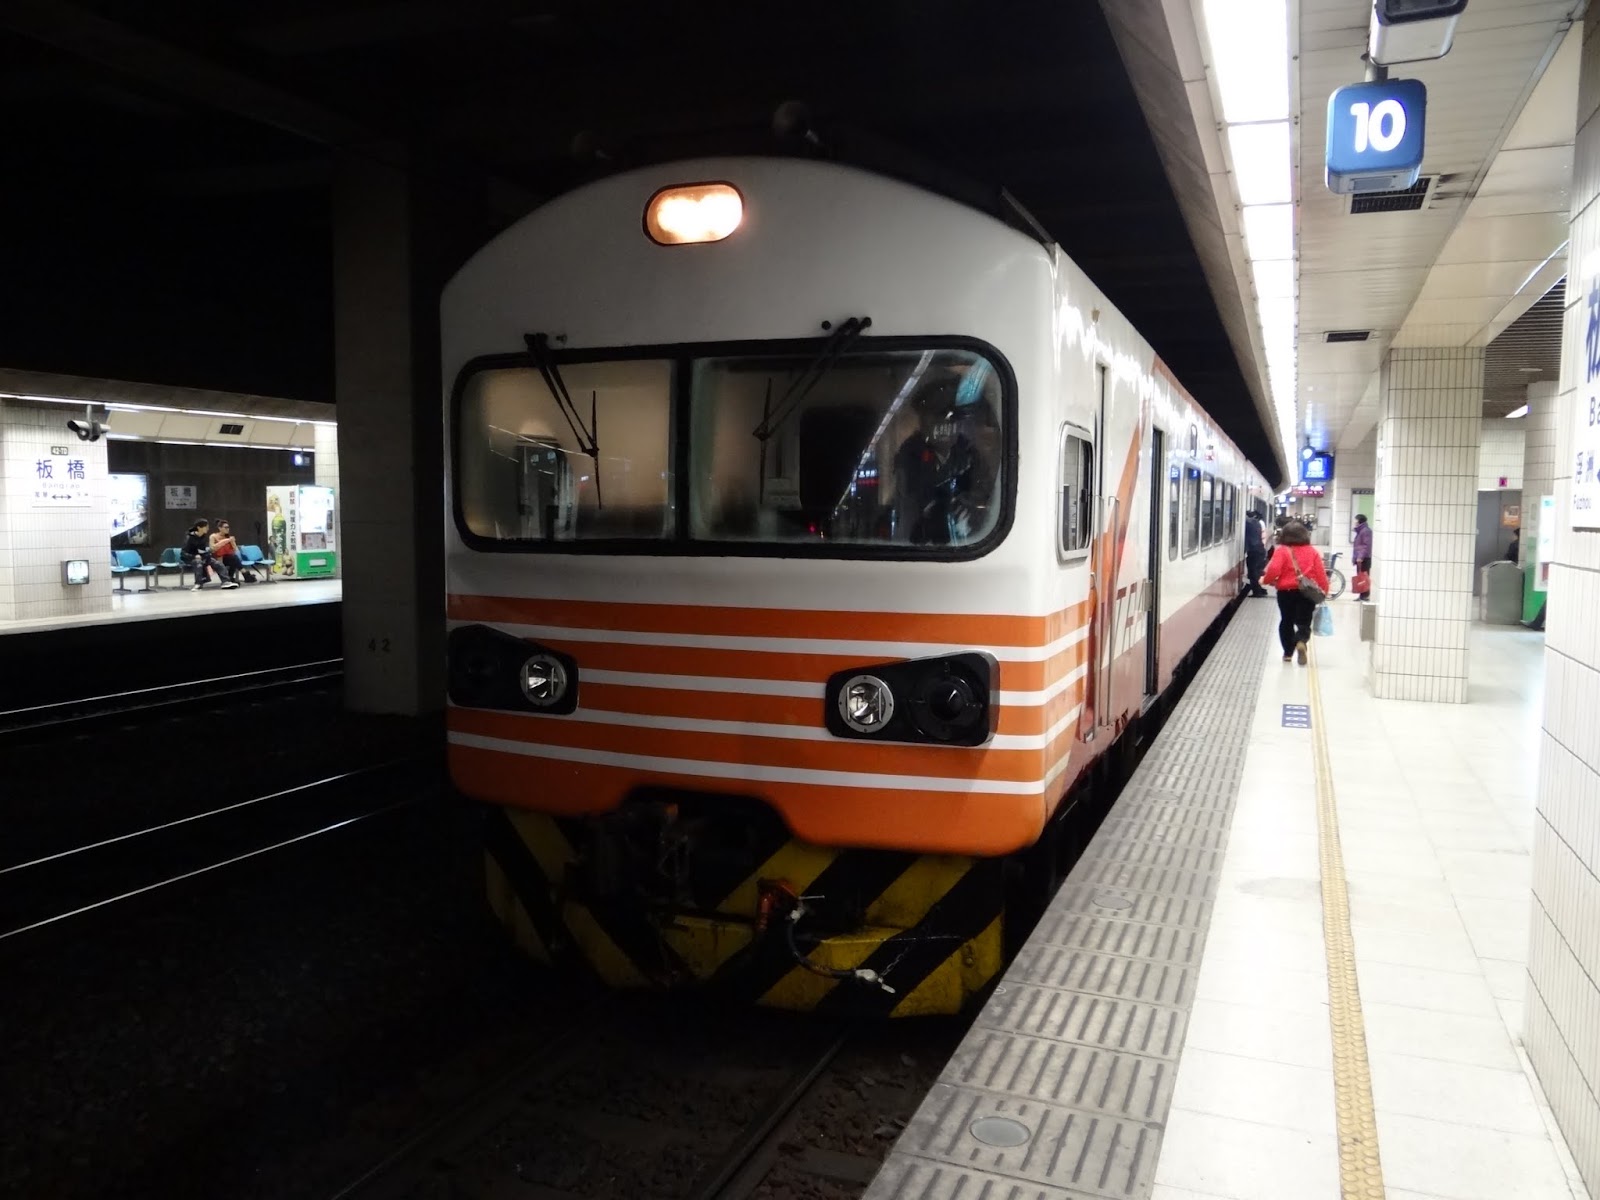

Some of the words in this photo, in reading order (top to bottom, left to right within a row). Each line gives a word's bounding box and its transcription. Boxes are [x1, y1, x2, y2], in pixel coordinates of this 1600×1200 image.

[1350, 99, 1406, 152] 10
[36, 458, 85, 480] 板橋
[368, 637, 391, 653] 42
